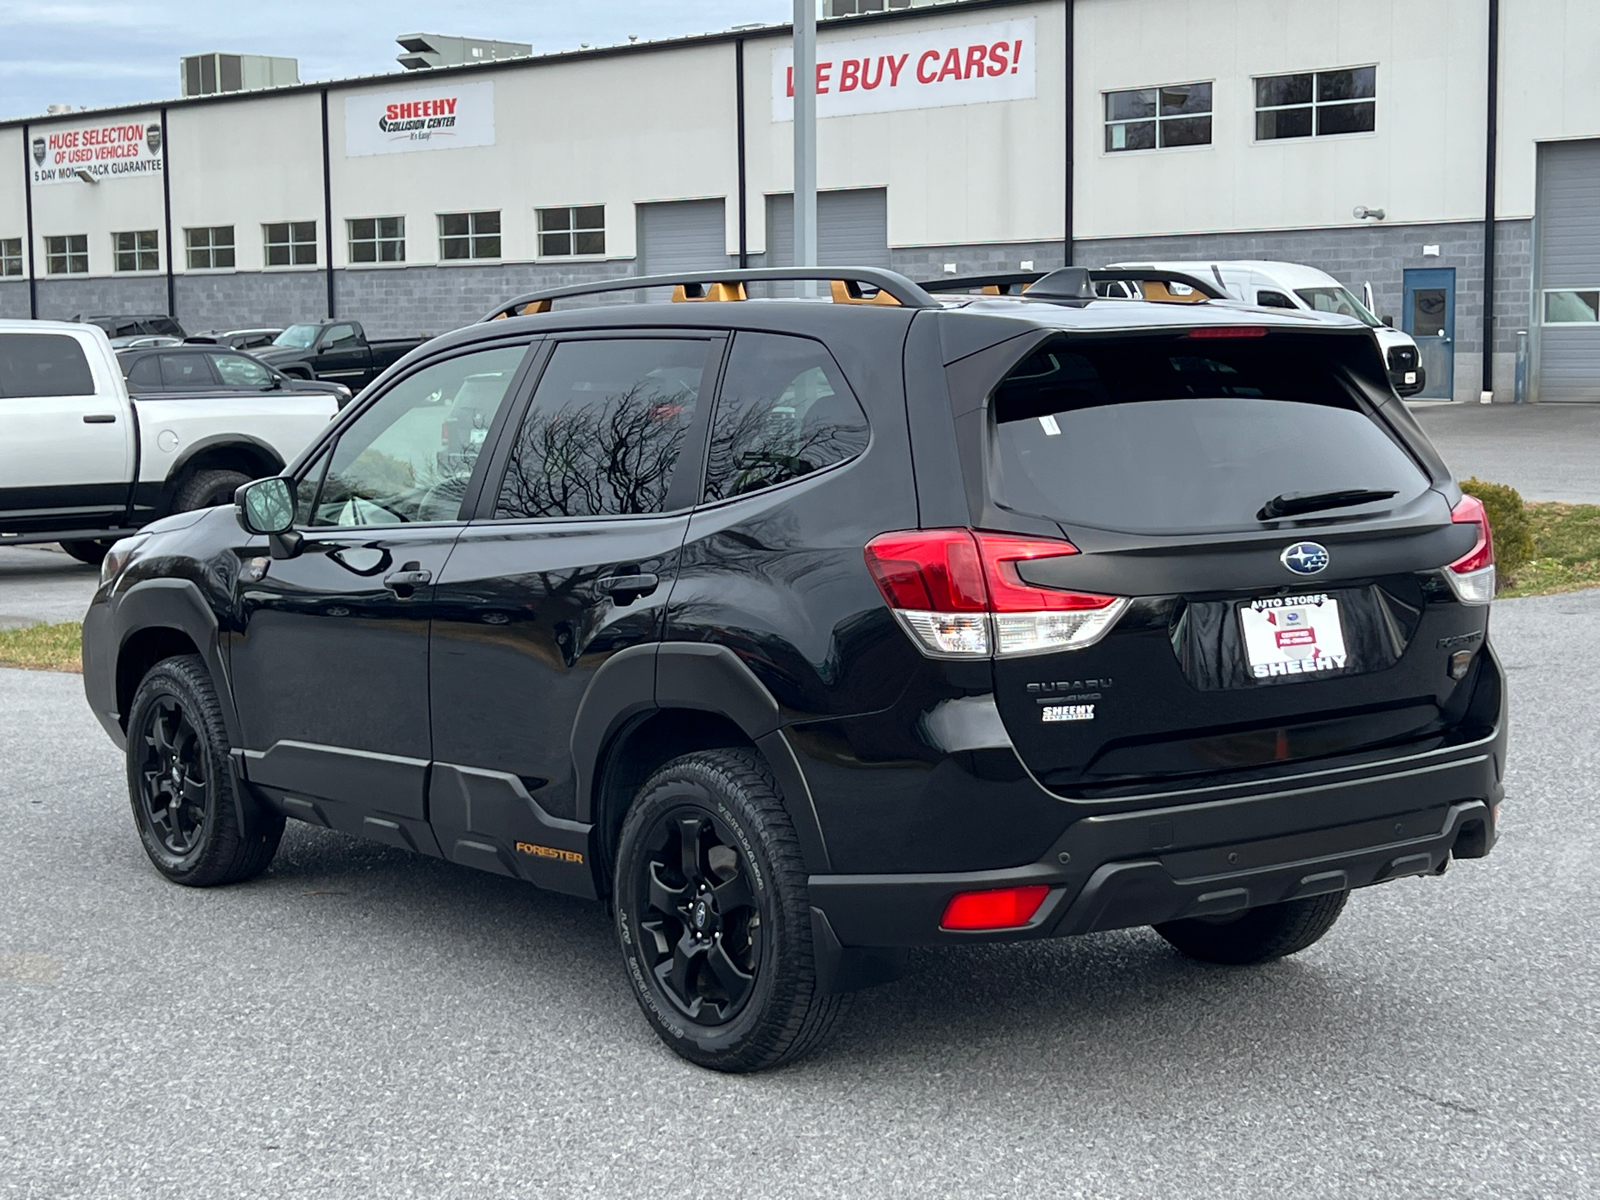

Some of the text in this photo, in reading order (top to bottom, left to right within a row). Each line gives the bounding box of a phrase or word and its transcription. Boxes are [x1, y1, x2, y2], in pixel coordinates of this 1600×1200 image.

[839, 53, 910, 92] BUY
[916, 40, 1023, 84] CARS!
[386, 98, 457, 120] SHEEHY
[387, 116, 456, 132] COLLISION CENTER
[49, 125, 144, 150] HUGE SELECTION
[54, 143, 139, 165] OF USED VEHICLES
[34, 171, 39, 181] 5
[41, 169, 56, 180] DAY
[111, 159, 162, 174] GUARANTEE
[1251, 599, 1282, 610] AUTO
[1253, 655, 1347, 678] SHEEHY
[1026, 678, 1112, 692] SUBARU
[1043, 704, 1094, 715] SHEEHY
[516, 842, 583, 864] FORESTER
